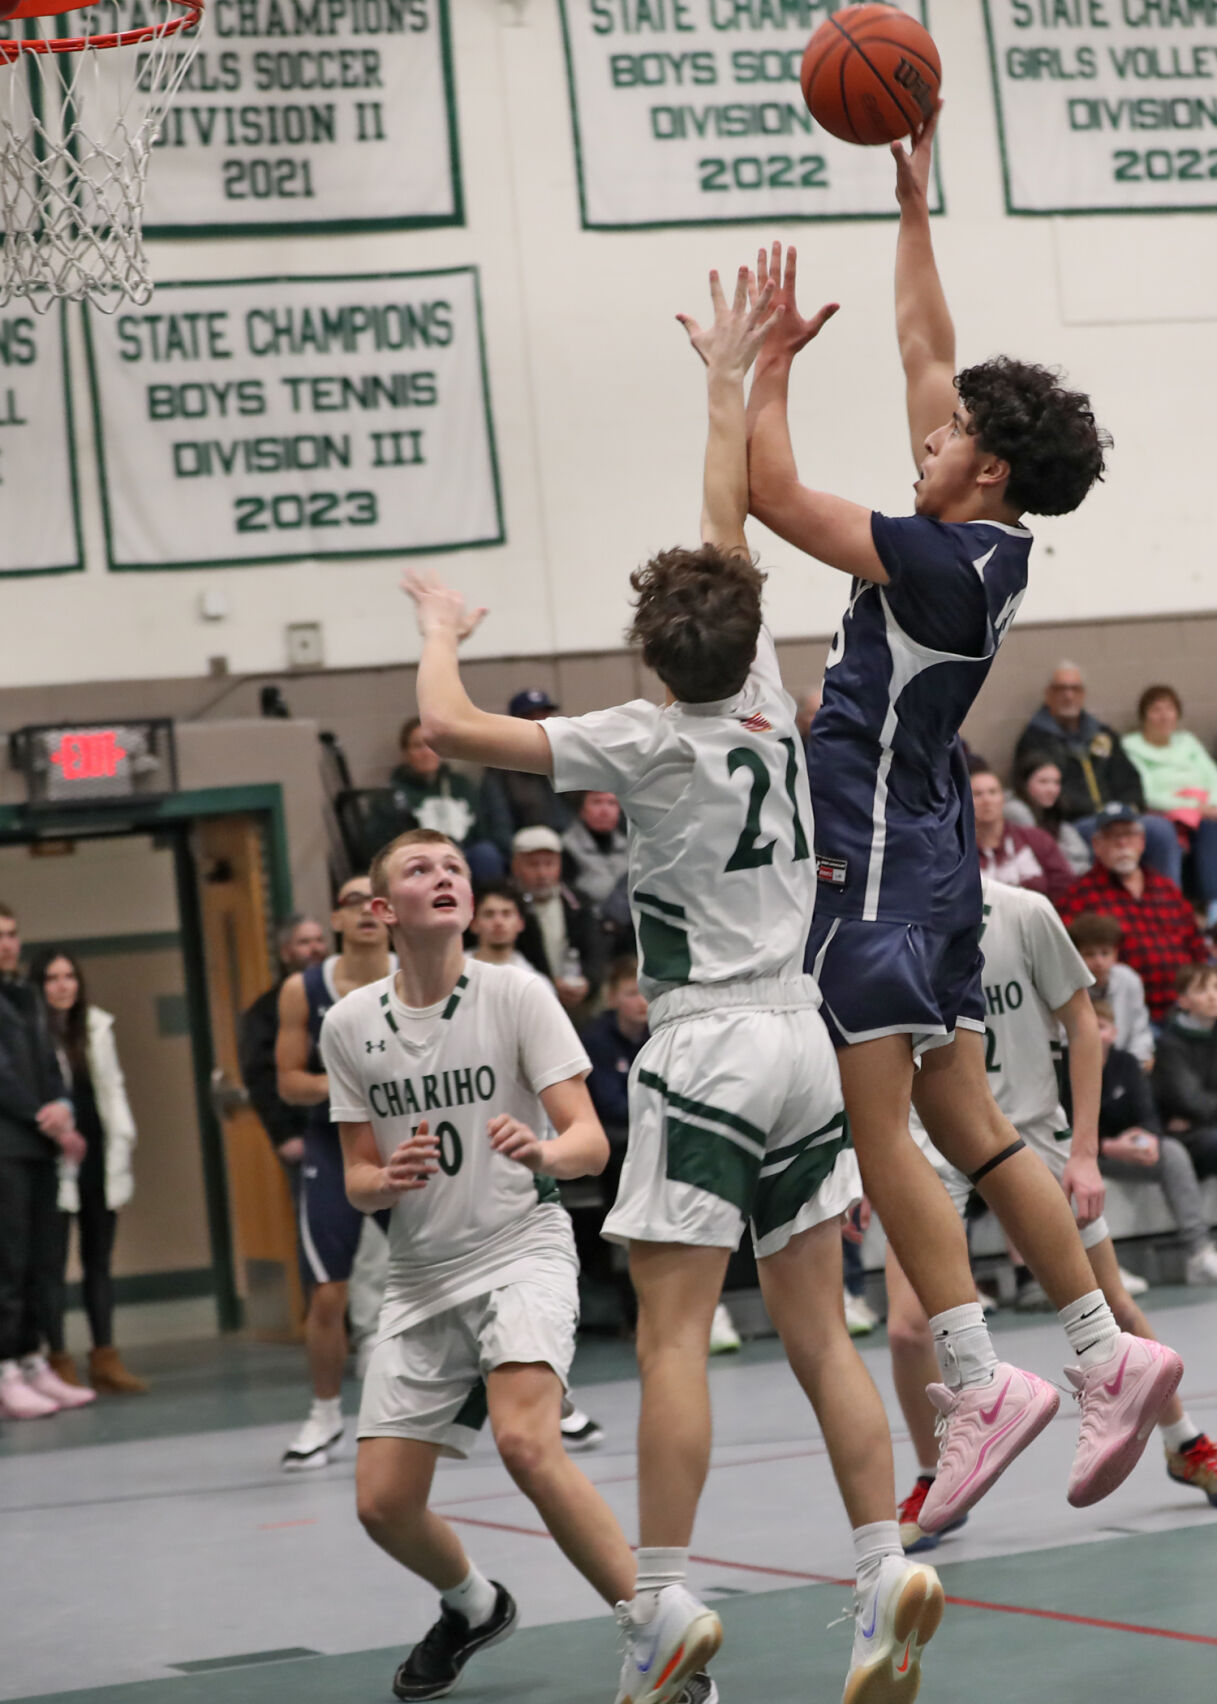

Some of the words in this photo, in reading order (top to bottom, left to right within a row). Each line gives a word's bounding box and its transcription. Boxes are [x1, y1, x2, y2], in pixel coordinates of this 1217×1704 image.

[214, 0, 428, 37] CHAMPIONS
[254, 49, 383, 91] SOCCER
[610, 52, 717, 88] BOYS
[1006, 46, 1097, 80] GIRLS
[1109, 46, 1217, 78] VOLLE
[356, 102, 386, 141] II
[651, 103, 815, 140] DIVISION
[1067, 97, 1217, 131] DIVISION
[223, 158, 315, 199] 2021
[698, 155, 829, 191] 2022
[117, 311, 233, 363] STATE
[246, 301, 454, 356] CHAMPIONS
[147, 379, 266, 421] BOYS
[281, 371, 438, 413] TENNIS
[173, 434, 351, 478] DIVISION
[371, 430, 425, 466] III
[234, 491, 379, 533] 2023
[61, 731, 117, 780] EXIT
[723, 736, 810, 873] 21
[984, 980, 1023, 1016] HO
[368, 1065, 496, 1119] CHARIHO
